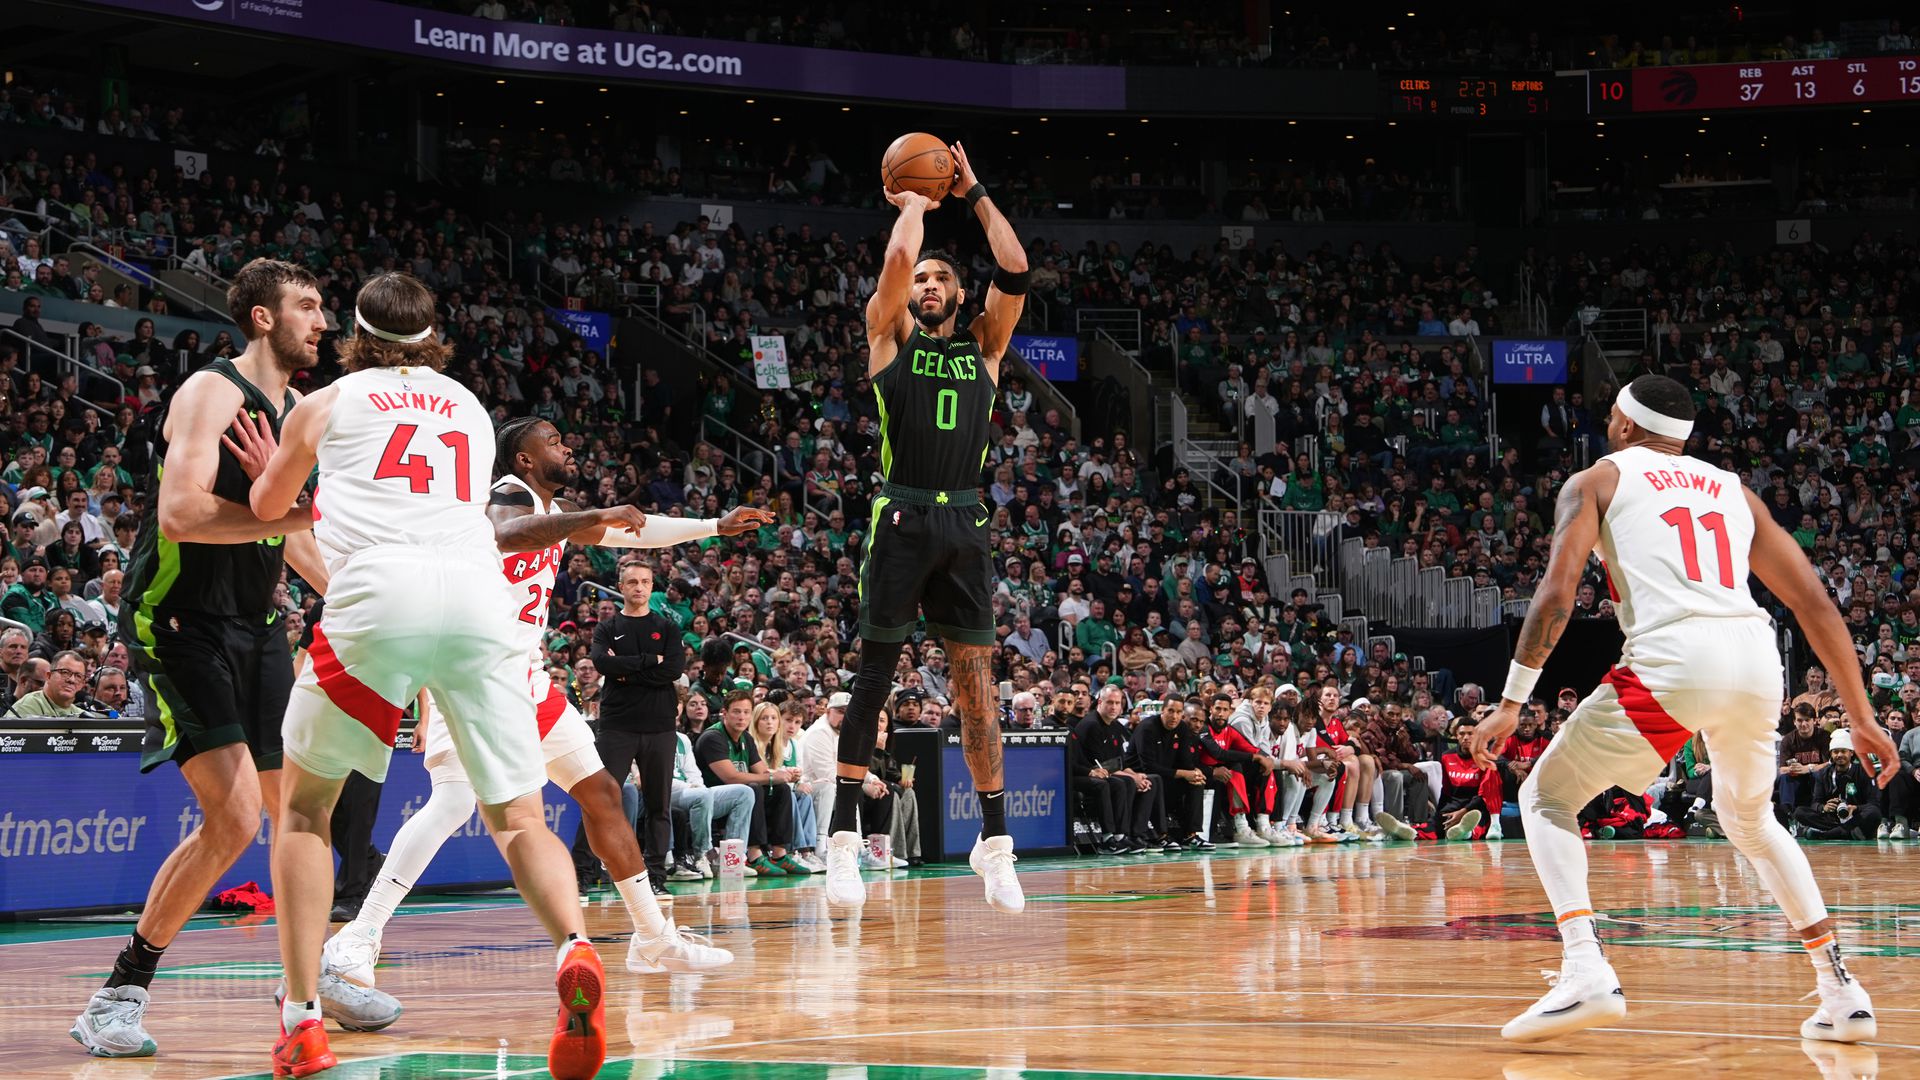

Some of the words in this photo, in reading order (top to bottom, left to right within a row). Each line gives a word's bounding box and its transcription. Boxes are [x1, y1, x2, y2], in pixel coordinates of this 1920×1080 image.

[250, 2, 273, 16] Facility
[274, 6, 303, 18] Services
[414, 19, 486, 54] Learn
[493, 32, 569, 62] More
[577, 42, 606, 65] at
[615, 42, 742, 75] UG2.com
[1739, 68, 1763, 78] REB
[1791, 65, 1816, 76] AST
[1847, 63, 1868, 73] STL
[1898, 60, 1917, 71] TO
[1399, 79, 1432, 91] CELTICS
[1458, 80, 1498, 98] 2:27
[1511, 80, 1545, 92] RAPTORS
[1599, 81, 1625, 102] 10
[1740, 83, 1764, 101] 37
[1794, 81, 1816, 99] 13
[1852, 79, 1865, 96] 6
[1898, 76, 1920, 94] 15
[186, 156, 196, 175] 3
[712, 208, 721, 226] 4
[1232, 229, 1241, 246] 5
[1789, 223, 1798, 240] 6
[912, 349, 977, 381] CELICS
[1020, 348, 1066, 361] ULTRA
[1505, 353, 1554, 365] ULTRA
[368, 391, 458, 419] OLYNYK
[936, 389, 958, 430] 0
[373, 423, 471, 502] 41
[1643, 470, 1722, 499] BROWN
[1659, 506, 1735, 590] 11
[513, 547, 559, 578] RAPO
[949, 781, 1056, 820] tickmaster
